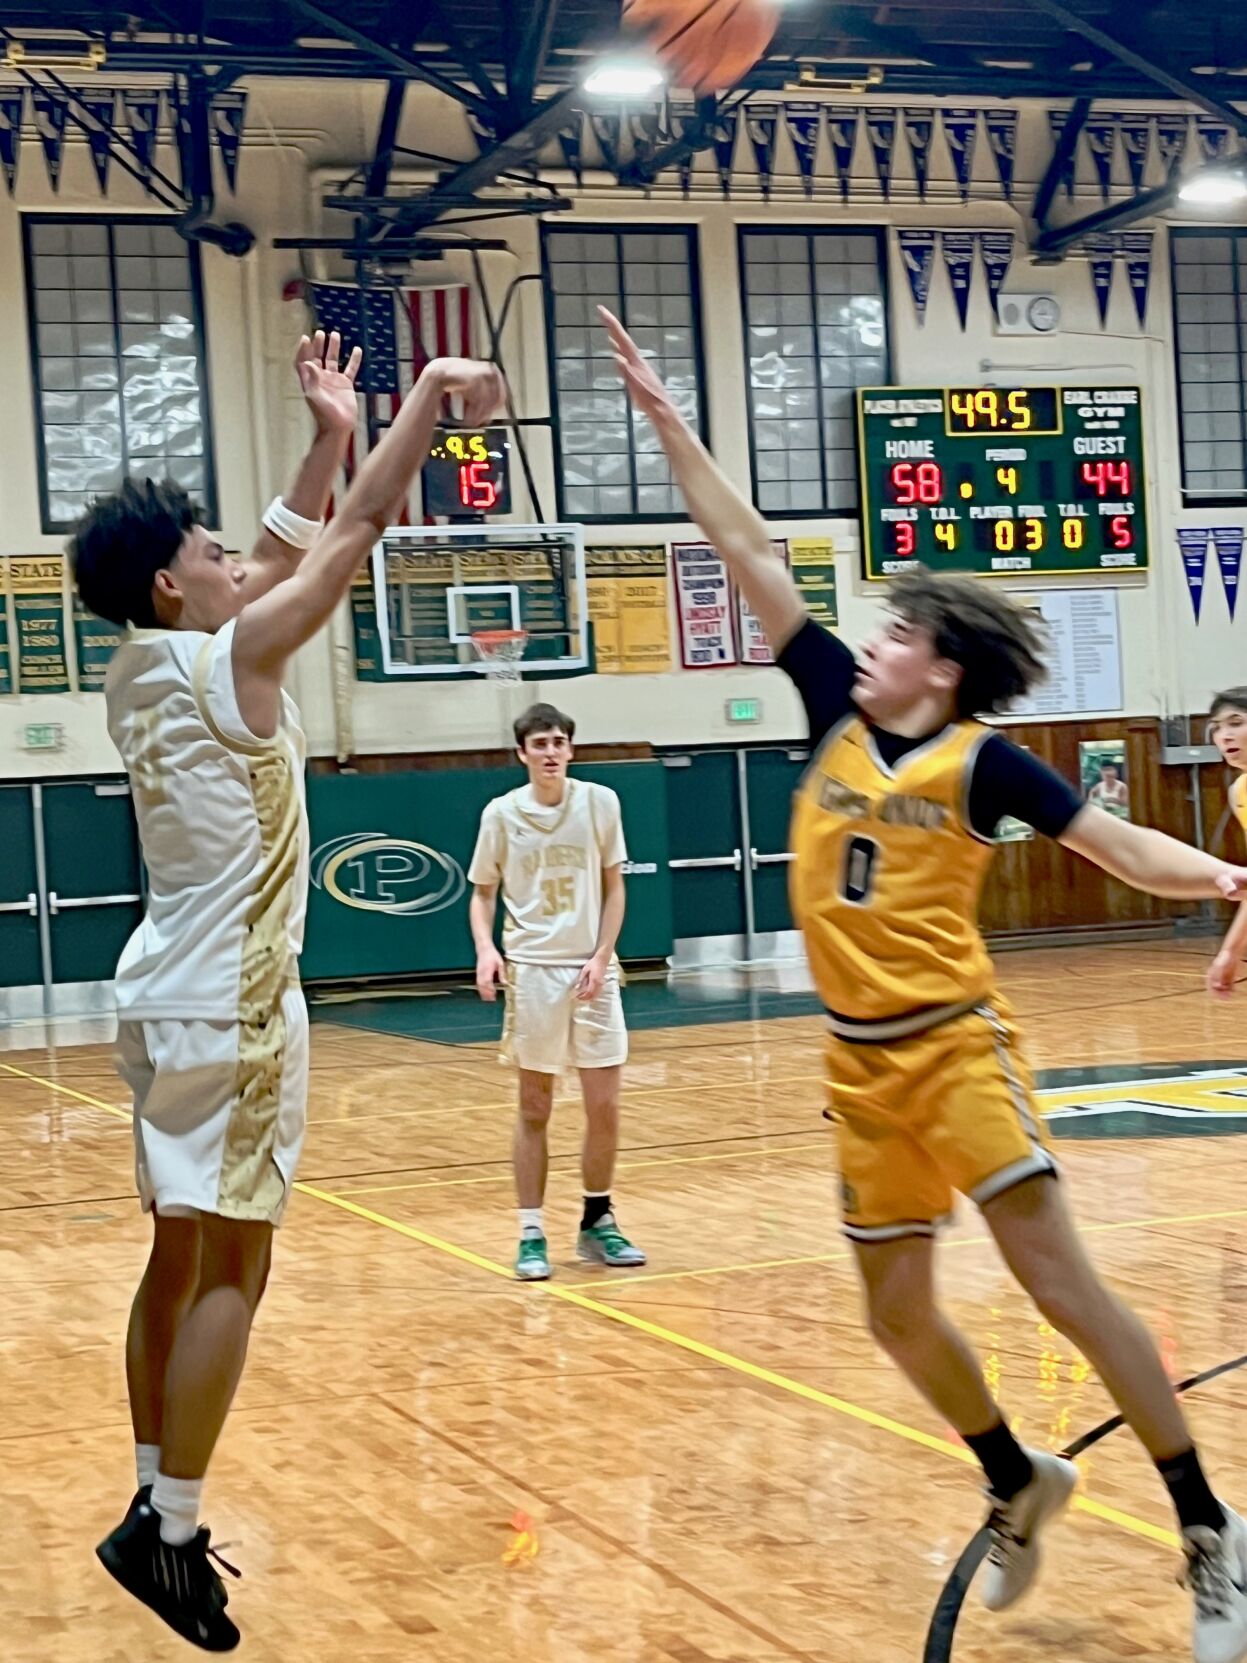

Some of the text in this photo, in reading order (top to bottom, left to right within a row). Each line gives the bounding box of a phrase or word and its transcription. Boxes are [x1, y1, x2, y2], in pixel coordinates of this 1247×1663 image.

[951, 390, 1031, 429] 49.5
[885, 440, 935, 458] HOME
[1073, 436, 1126, 454] GUEST
[460, 463, 495, 507] 15
[891, 462, 941, 503] 58
[997, 467, 1016, 494] 4
[1083, 461, 1129, 496] 44
[895, 523, 914, 555] 3
[935, 523, 955, 550] 4
[1063, 519, 1082, 549] 0
[1111, 516, 1131, 548] 5
[846, 834, 876, 904] 0
